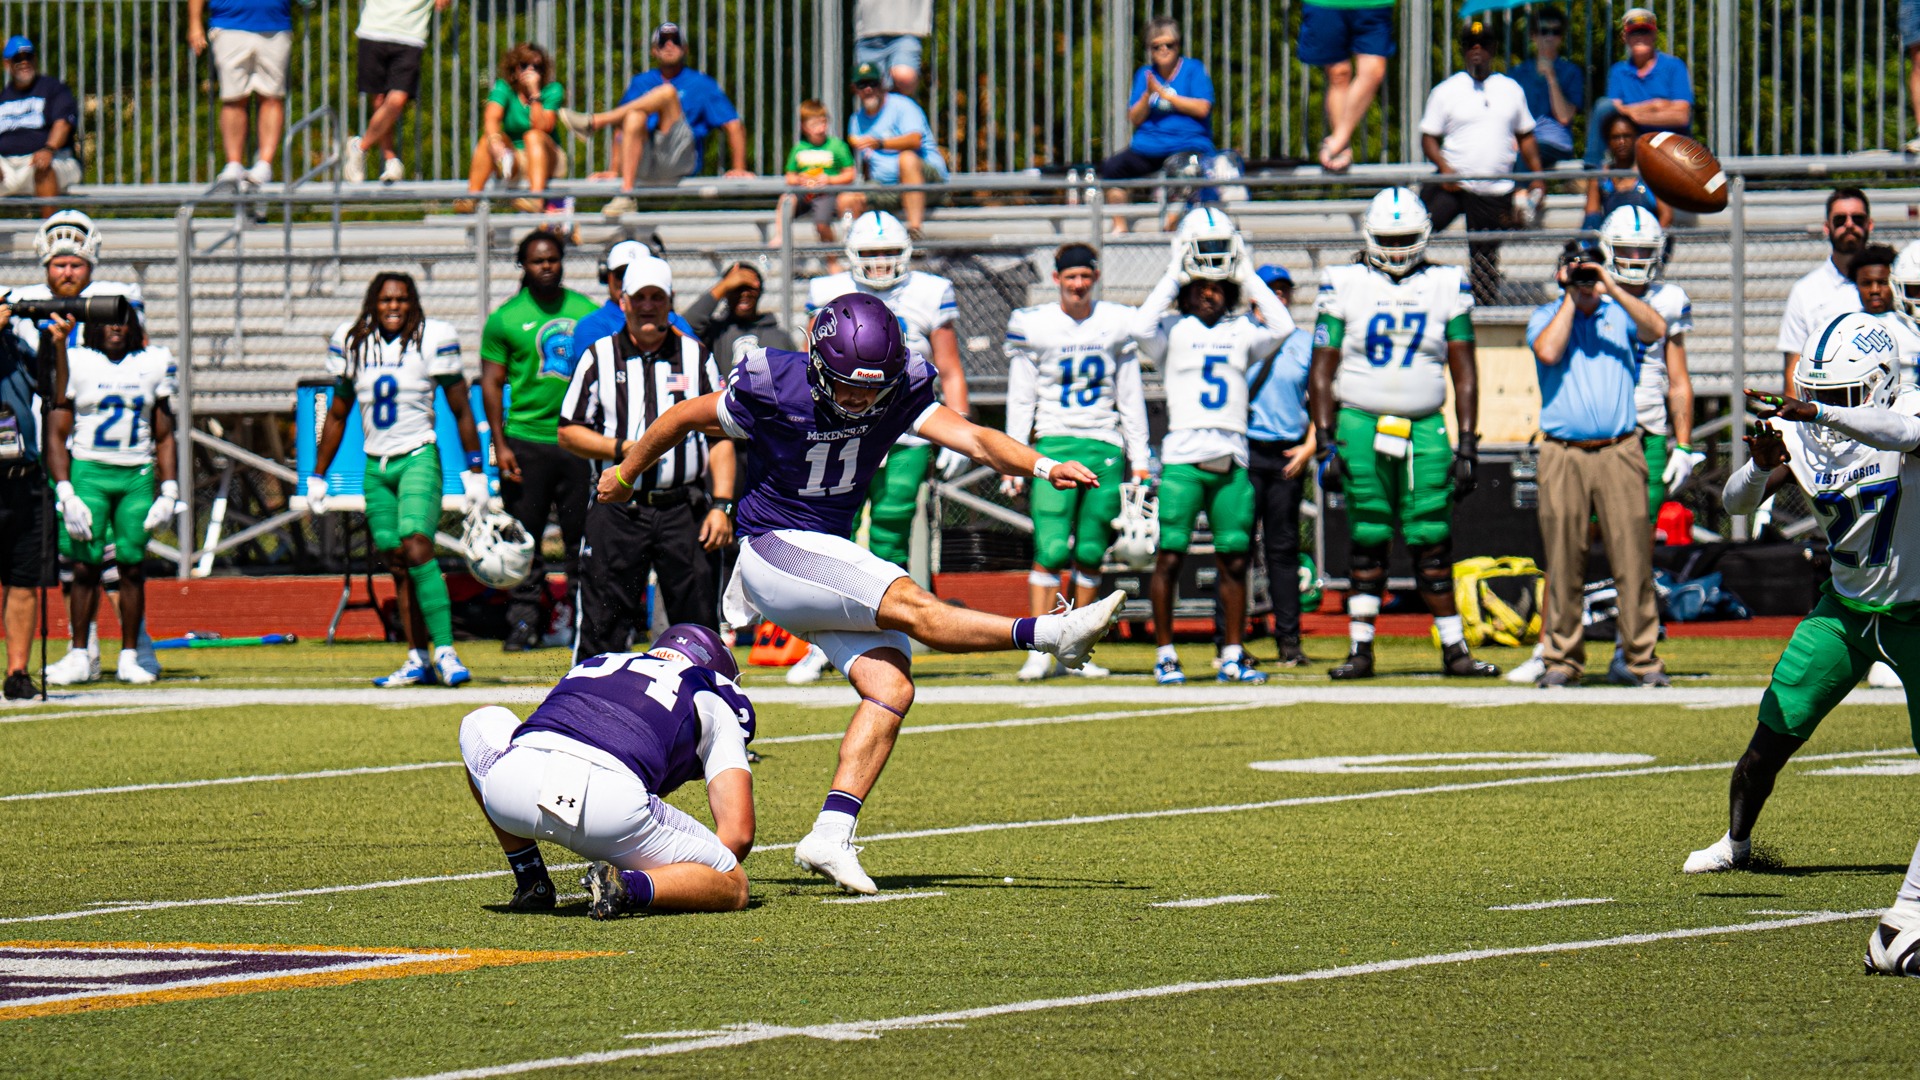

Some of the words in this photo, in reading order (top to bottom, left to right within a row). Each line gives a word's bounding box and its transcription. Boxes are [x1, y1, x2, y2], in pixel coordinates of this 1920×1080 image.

[1366, 312, 1427, 367] 67
[1852, 328, 1894, 355] UWF
[373, 374, 398, 430] 8
[857, 371, 883, 379] Riddell
[1058, 354, 1105, 408] 13
[1200, 355, 1228, 410] 5
[94, 394, 145, 450] 21
[797, 437, 861, 497] 11
[1815, 472, 1840, 485] WEST
[1842, 462, 1881, 482] FLORIDA
[1811, 475, 1903, 569] 27
[565, 652, 683, 712] 34
